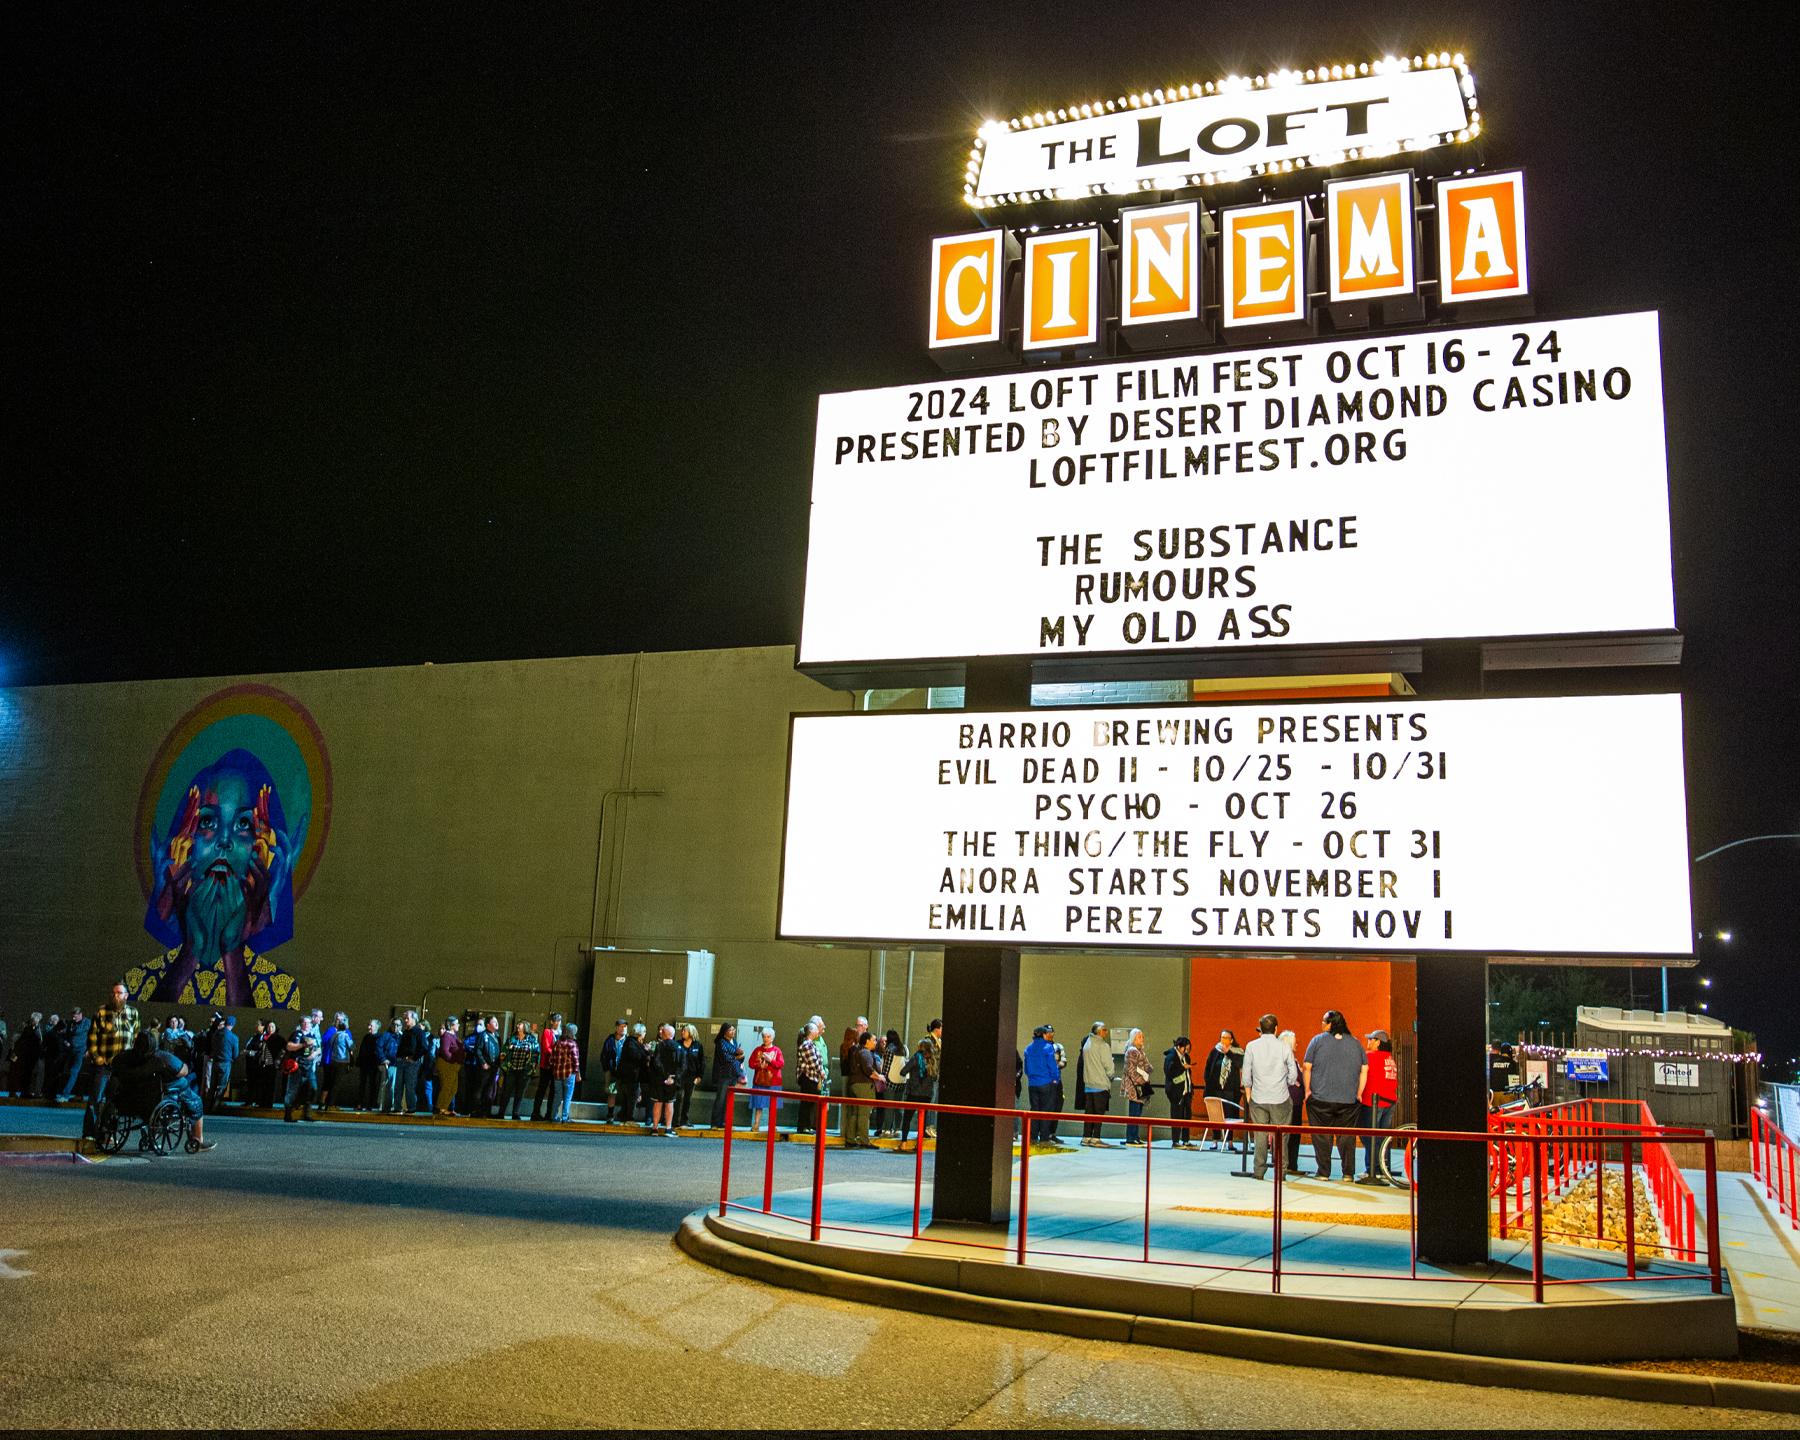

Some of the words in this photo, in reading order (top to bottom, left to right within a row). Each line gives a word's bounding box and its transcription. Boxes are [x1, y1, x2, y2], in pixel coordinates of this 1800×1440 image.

[1041, 135, 1117, 171] THE
[1136, 97, 1390, 168] LOFT
[944, 197, 1515, 329] CINEMA
[907, 386, 990, 422] 2024
[1009, 374, 1098, 412] LOFT
[1117, 365, 1198, 403] FILM
[1213, 354, 1302, 393] FEST
[1326, 344, 1405, 383] OCT
[1427, 339, 1465, 374] 16
[1512, 330, 1561, 366] 24
[835, 422, 1025, 465] PRESENTED
[1042, 415, 1089, 448] BY
[1110, 401, 1246, 443] DESERT
[1265, 384, 1447, 430] DIAMOND
[1473, 367, 1631, 412] CASINO
[1030, 428, 1406, 488] LOFTFILMFEST.ORG
[1037, 533, 1102, 566] THE
[1134, 516, 1357, 561] SUBSTANCE
[1076, 565, 1256, 605] RUMOURS
[1040, 614, 1095, 647] MY
[1122, 610, 1196, 644] OLD
[1218, 604, 1292, 640] ASS
[959, 721, 1070, 749] BARRIO
[1094, 717, 1232, 746] BREWING
[1258, 713, 1427, 744] PRESENTS
[939, 759, 996, 785] EVIL
[1023, 758, 1099, 783] DEAD
[1194, 754, 1291, 782] 10/25
[1353, 751, 1446, 780] 10/31
[1036, 793, 1161, 821] PSYCHO
[1225, 792, 1290, 819] OCT
[1321, 791, 1356, 819] 26
[943, 831, 996, 857] THE
[1015, 831, 1188, 857] THING/THE
[1210, 830, 1269, 858] FLY
[1323, 830, 1390, 859] OCT
[1411, 829, 1440, 859] 31
[939, 867, 1039, 894] ANORA
[1069, 868, 1189, 896] STARTS
[1220, 869, 1398, 898] NOVEMBER
[929, 904, 1026, 931] EMILIA
[1066, 906, 1162, 934] PEREZ
[1191, 907, 1320, 937] STARTS
[1353, 910, 1421, 938] NOV
